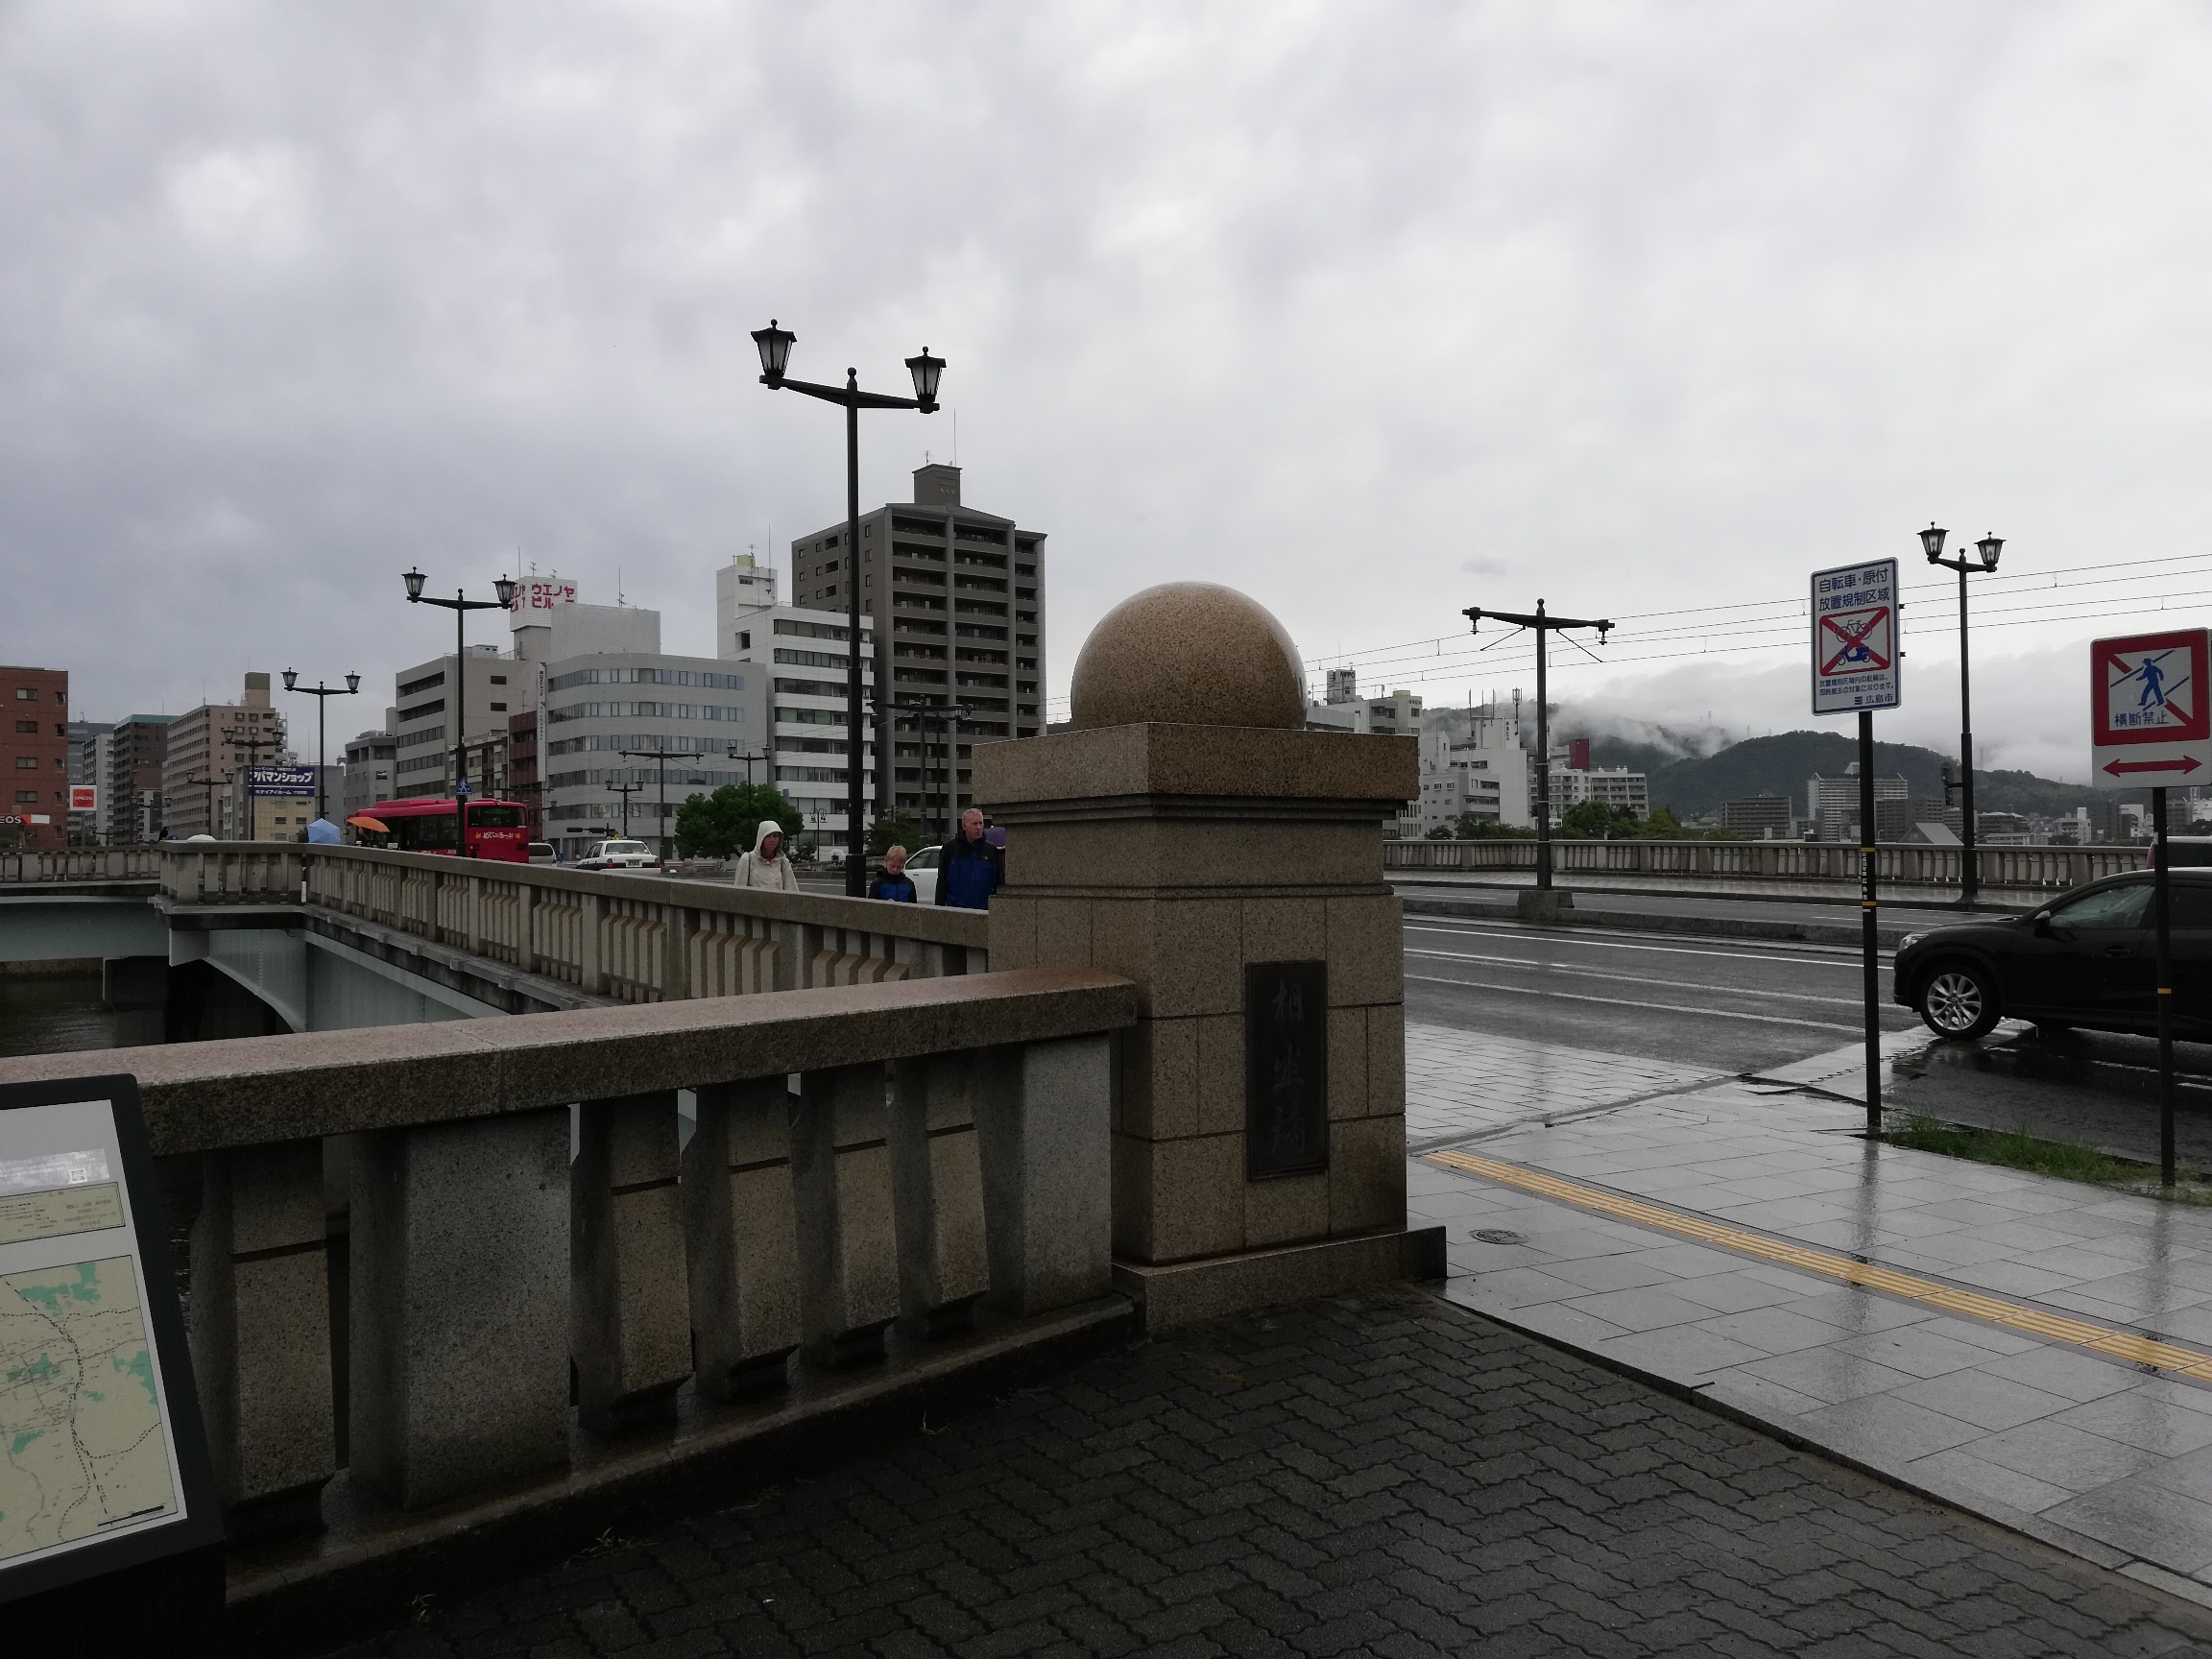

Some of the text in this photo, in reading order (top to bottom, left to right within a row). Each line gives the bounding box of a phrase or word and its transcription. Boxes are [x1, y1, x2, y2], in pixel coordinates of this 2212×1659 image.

[531, 583, 575, 597] ウエノヤ
[531, 595, 554, 609] ビル
[1818, 587, 1890, 612] 放置規制区域
[1865, 693, 1893, 704] 広島市
[2114, 710, 2169, 727] 横断禁止
